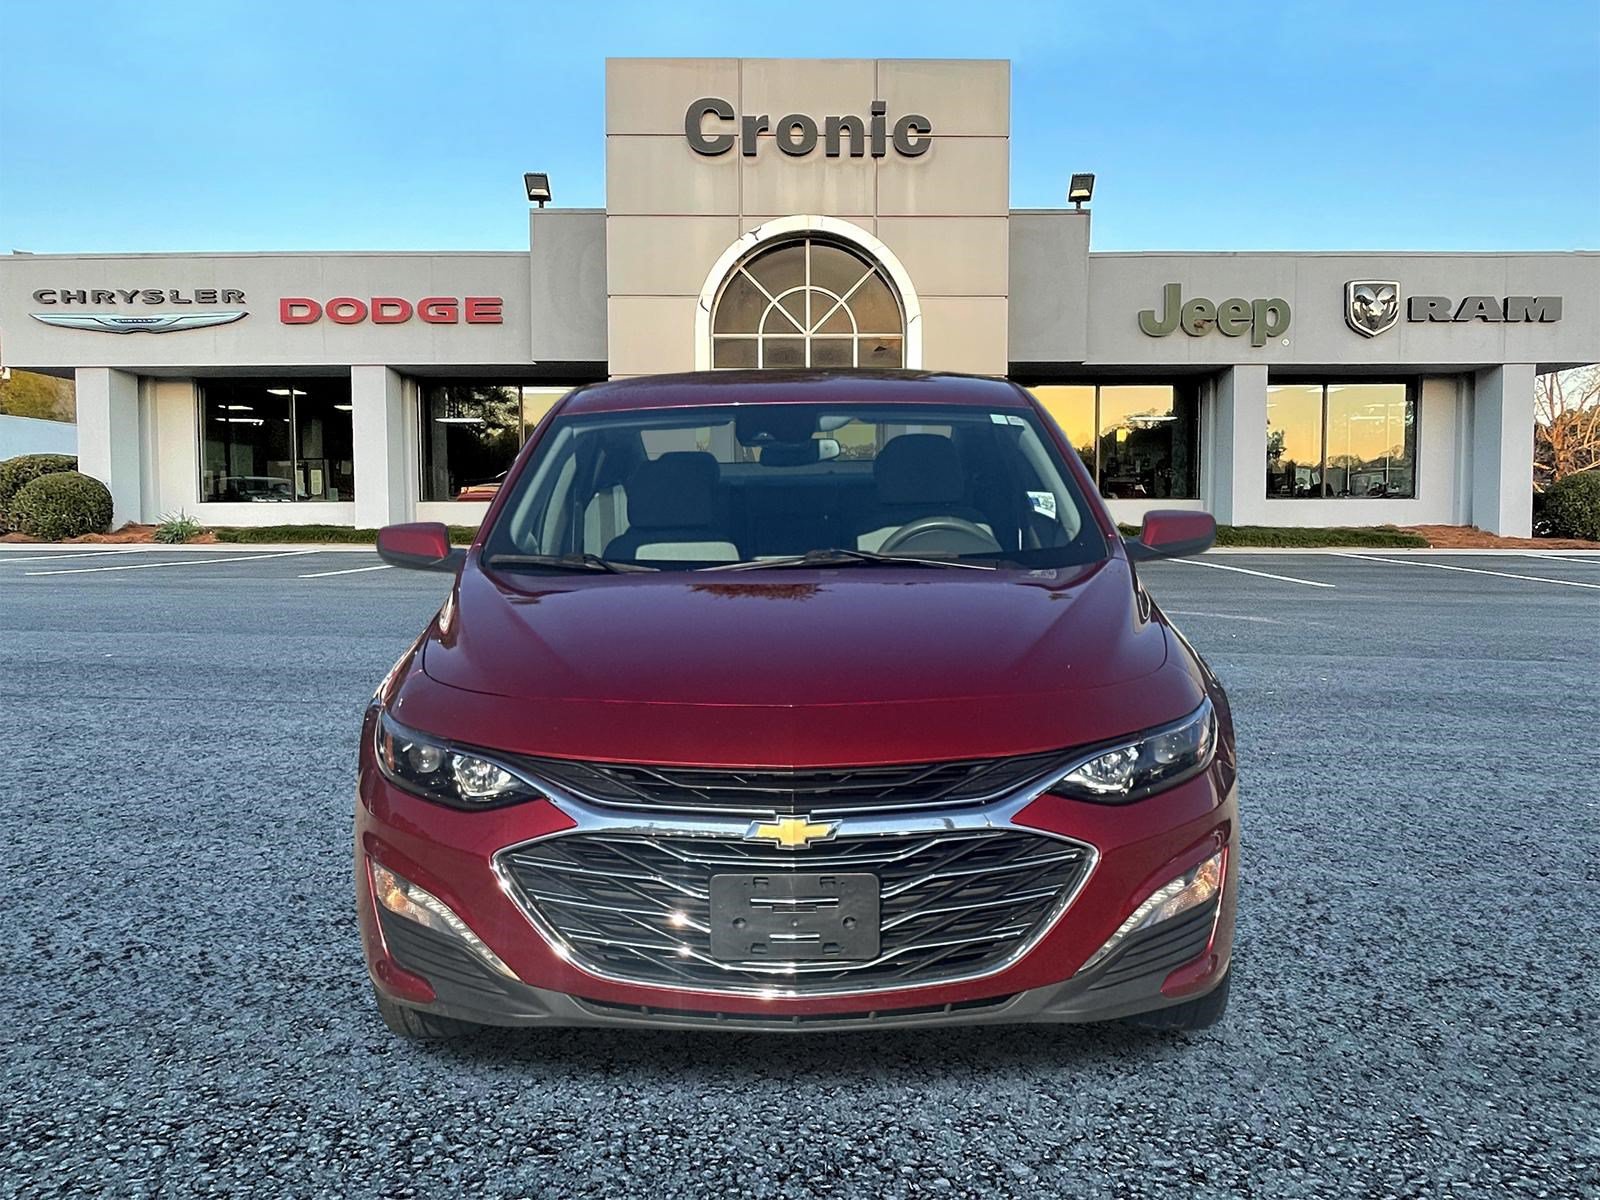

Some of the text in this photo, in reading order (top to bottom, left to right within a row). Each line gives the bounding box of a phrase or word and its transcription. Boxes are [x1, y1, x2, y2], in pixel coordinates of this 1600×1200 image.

[685, 98, 932, 157] Cronic
[32, 289, 246, 304] CHRYSLER
[1407, 296, 1563, 322] RAM
[280, 297, 503, 324] DODGE
[1138, 283, 1291, 347] Jeep
